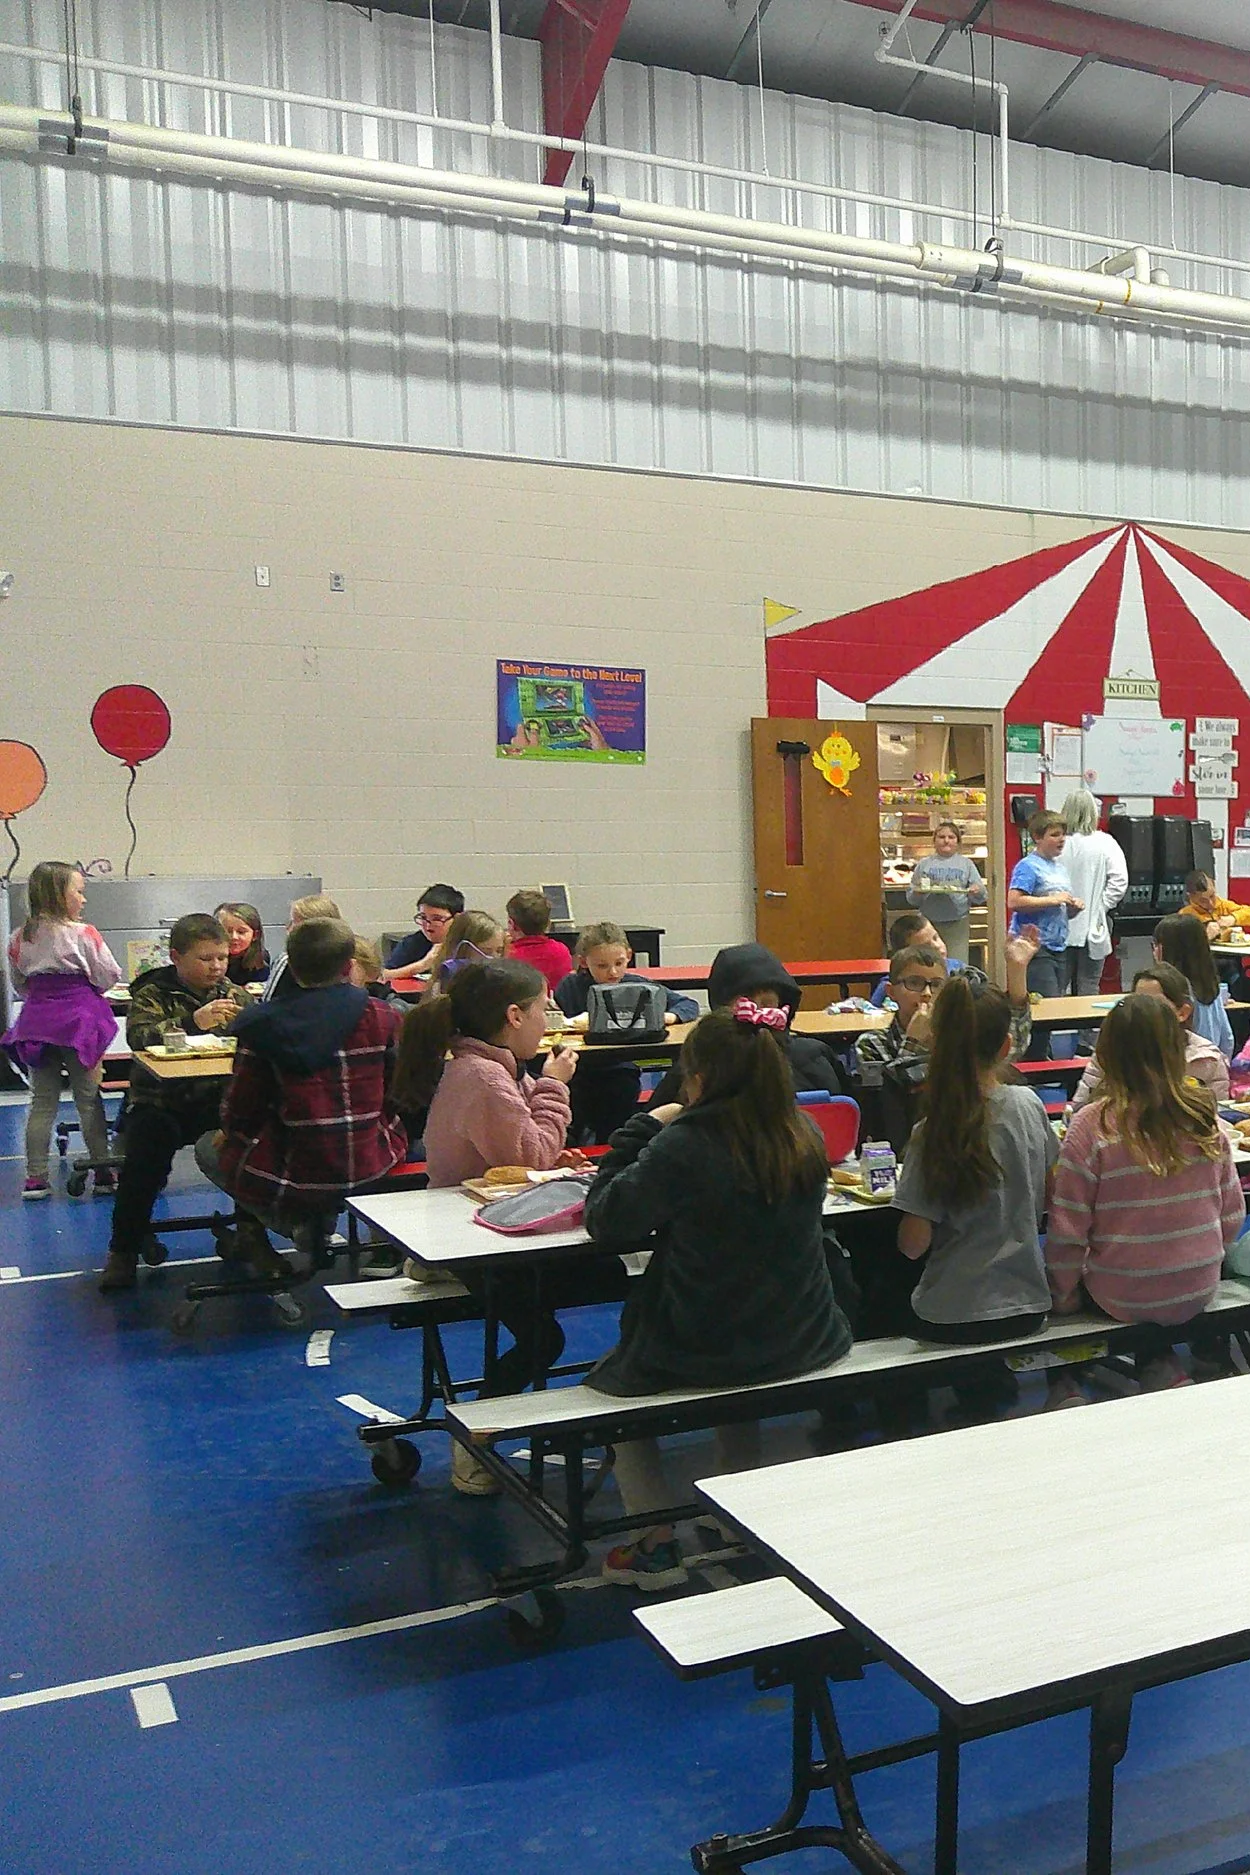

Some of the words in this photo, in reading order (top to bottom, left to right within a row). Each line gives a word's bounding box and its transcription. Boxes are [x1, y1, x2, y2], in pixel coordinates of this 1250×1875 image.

[501, 662, 521, 675] Take
[523, 664, 542, 676] Your
[544, 666, 569, 678] Game
[570, 667, 581, 679] to
[582, 668, 598, 680] the
[599, 669, 619, 682] Next
[620, 672, 642, 683] Level
[1108, 682, 1157, 695] KITCHEN
